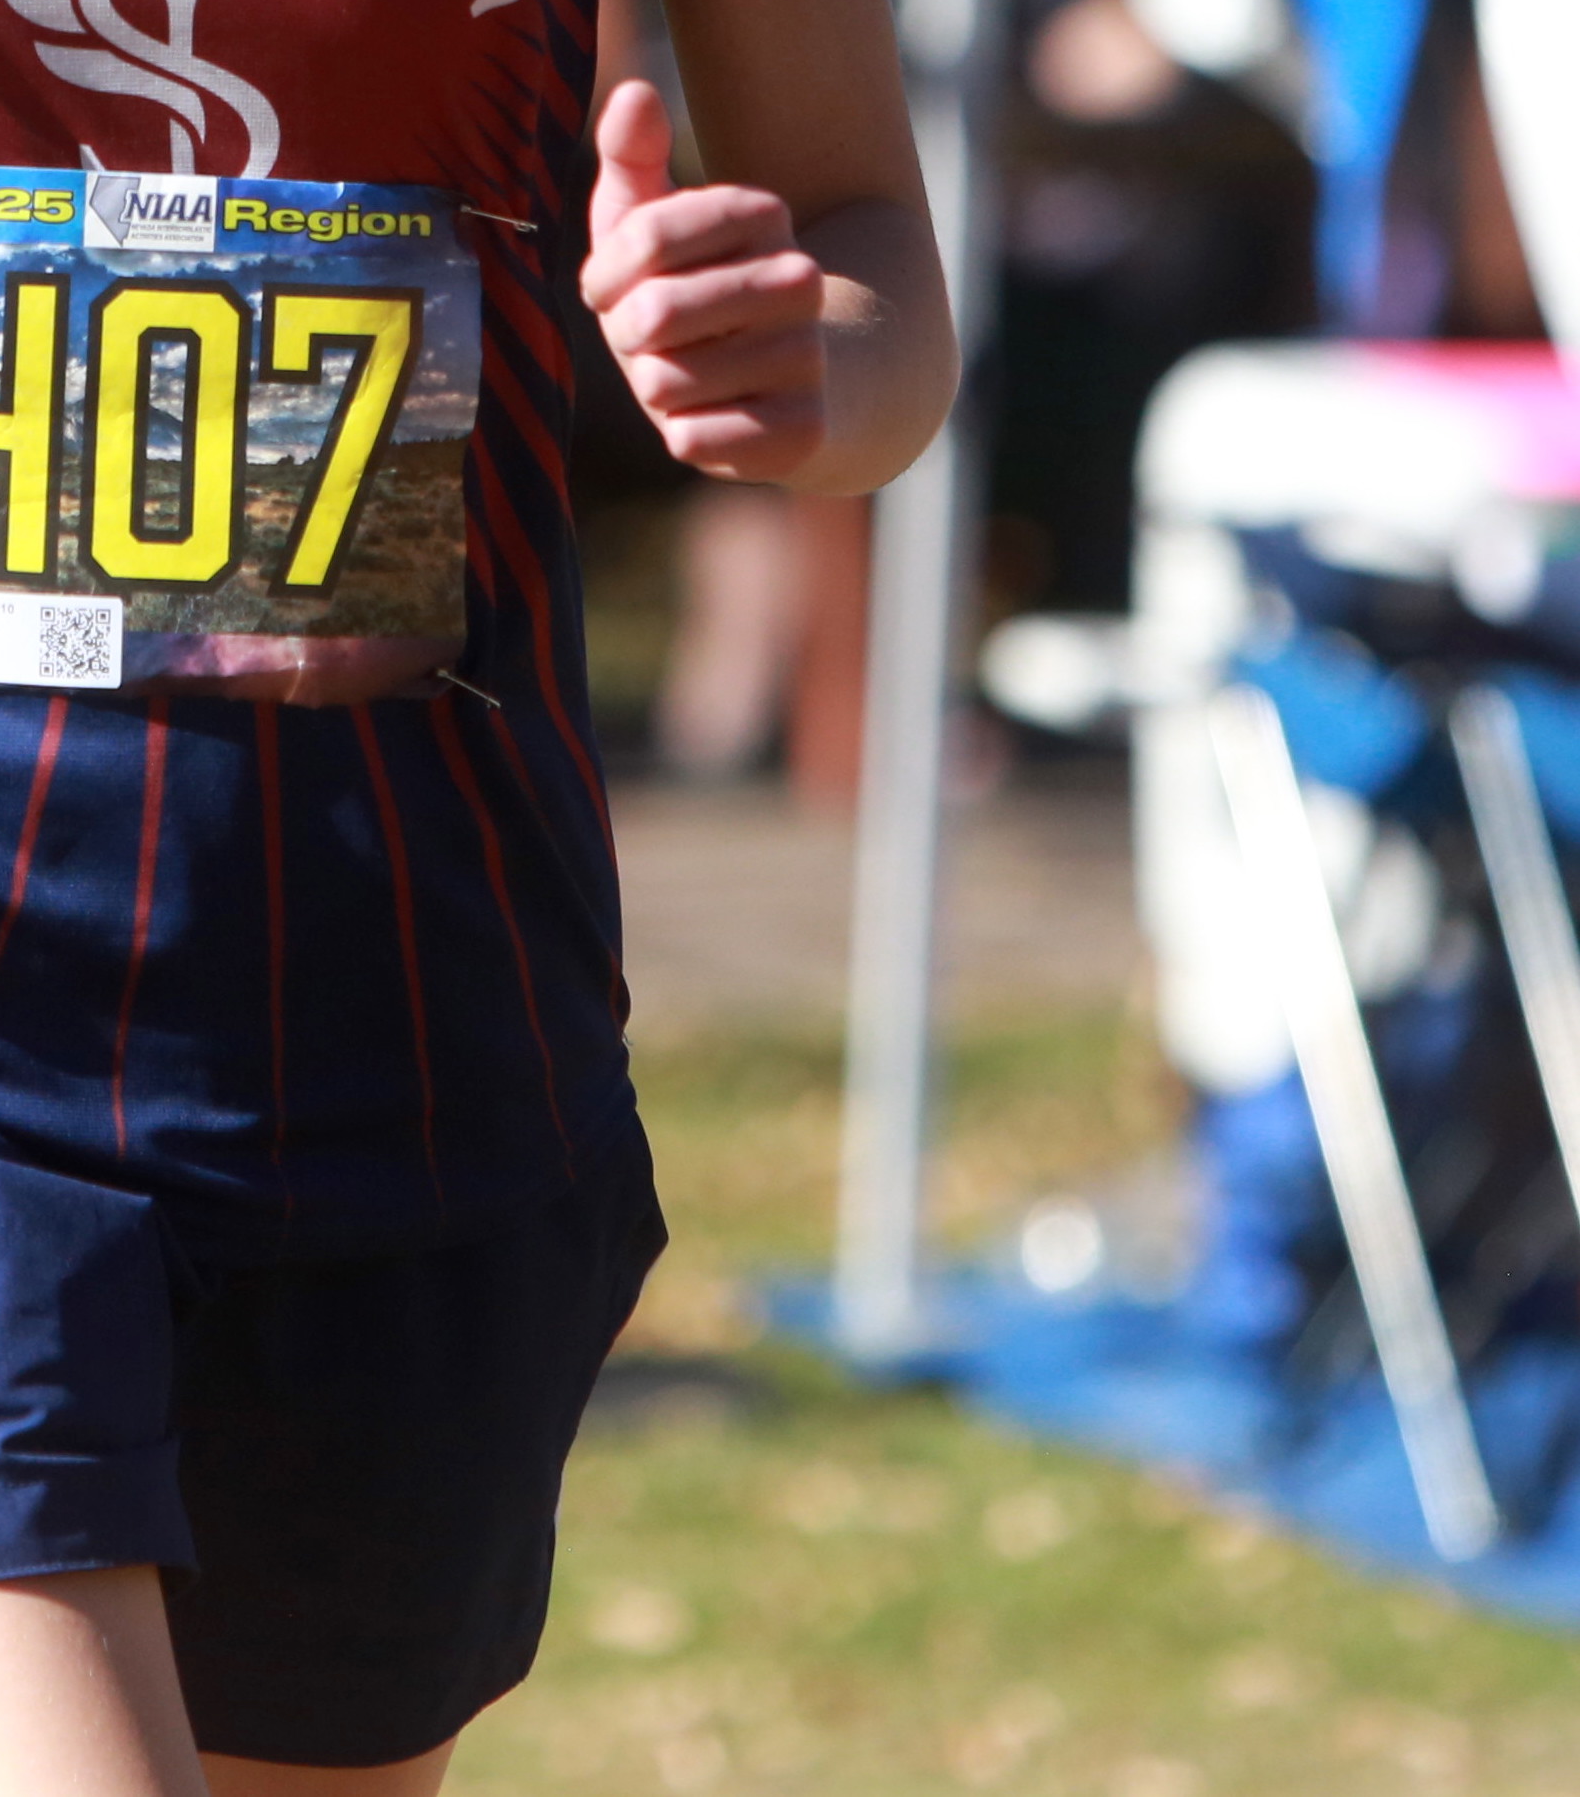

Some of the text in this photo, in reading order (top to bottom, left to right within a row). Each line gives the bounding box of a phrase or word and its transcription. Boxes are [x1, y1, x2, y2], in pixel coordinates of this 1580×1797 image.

[126, 193, 212, 221] NIAA
[223, 197, 433, 242] Region
[1, 603, 15, 615] 10
